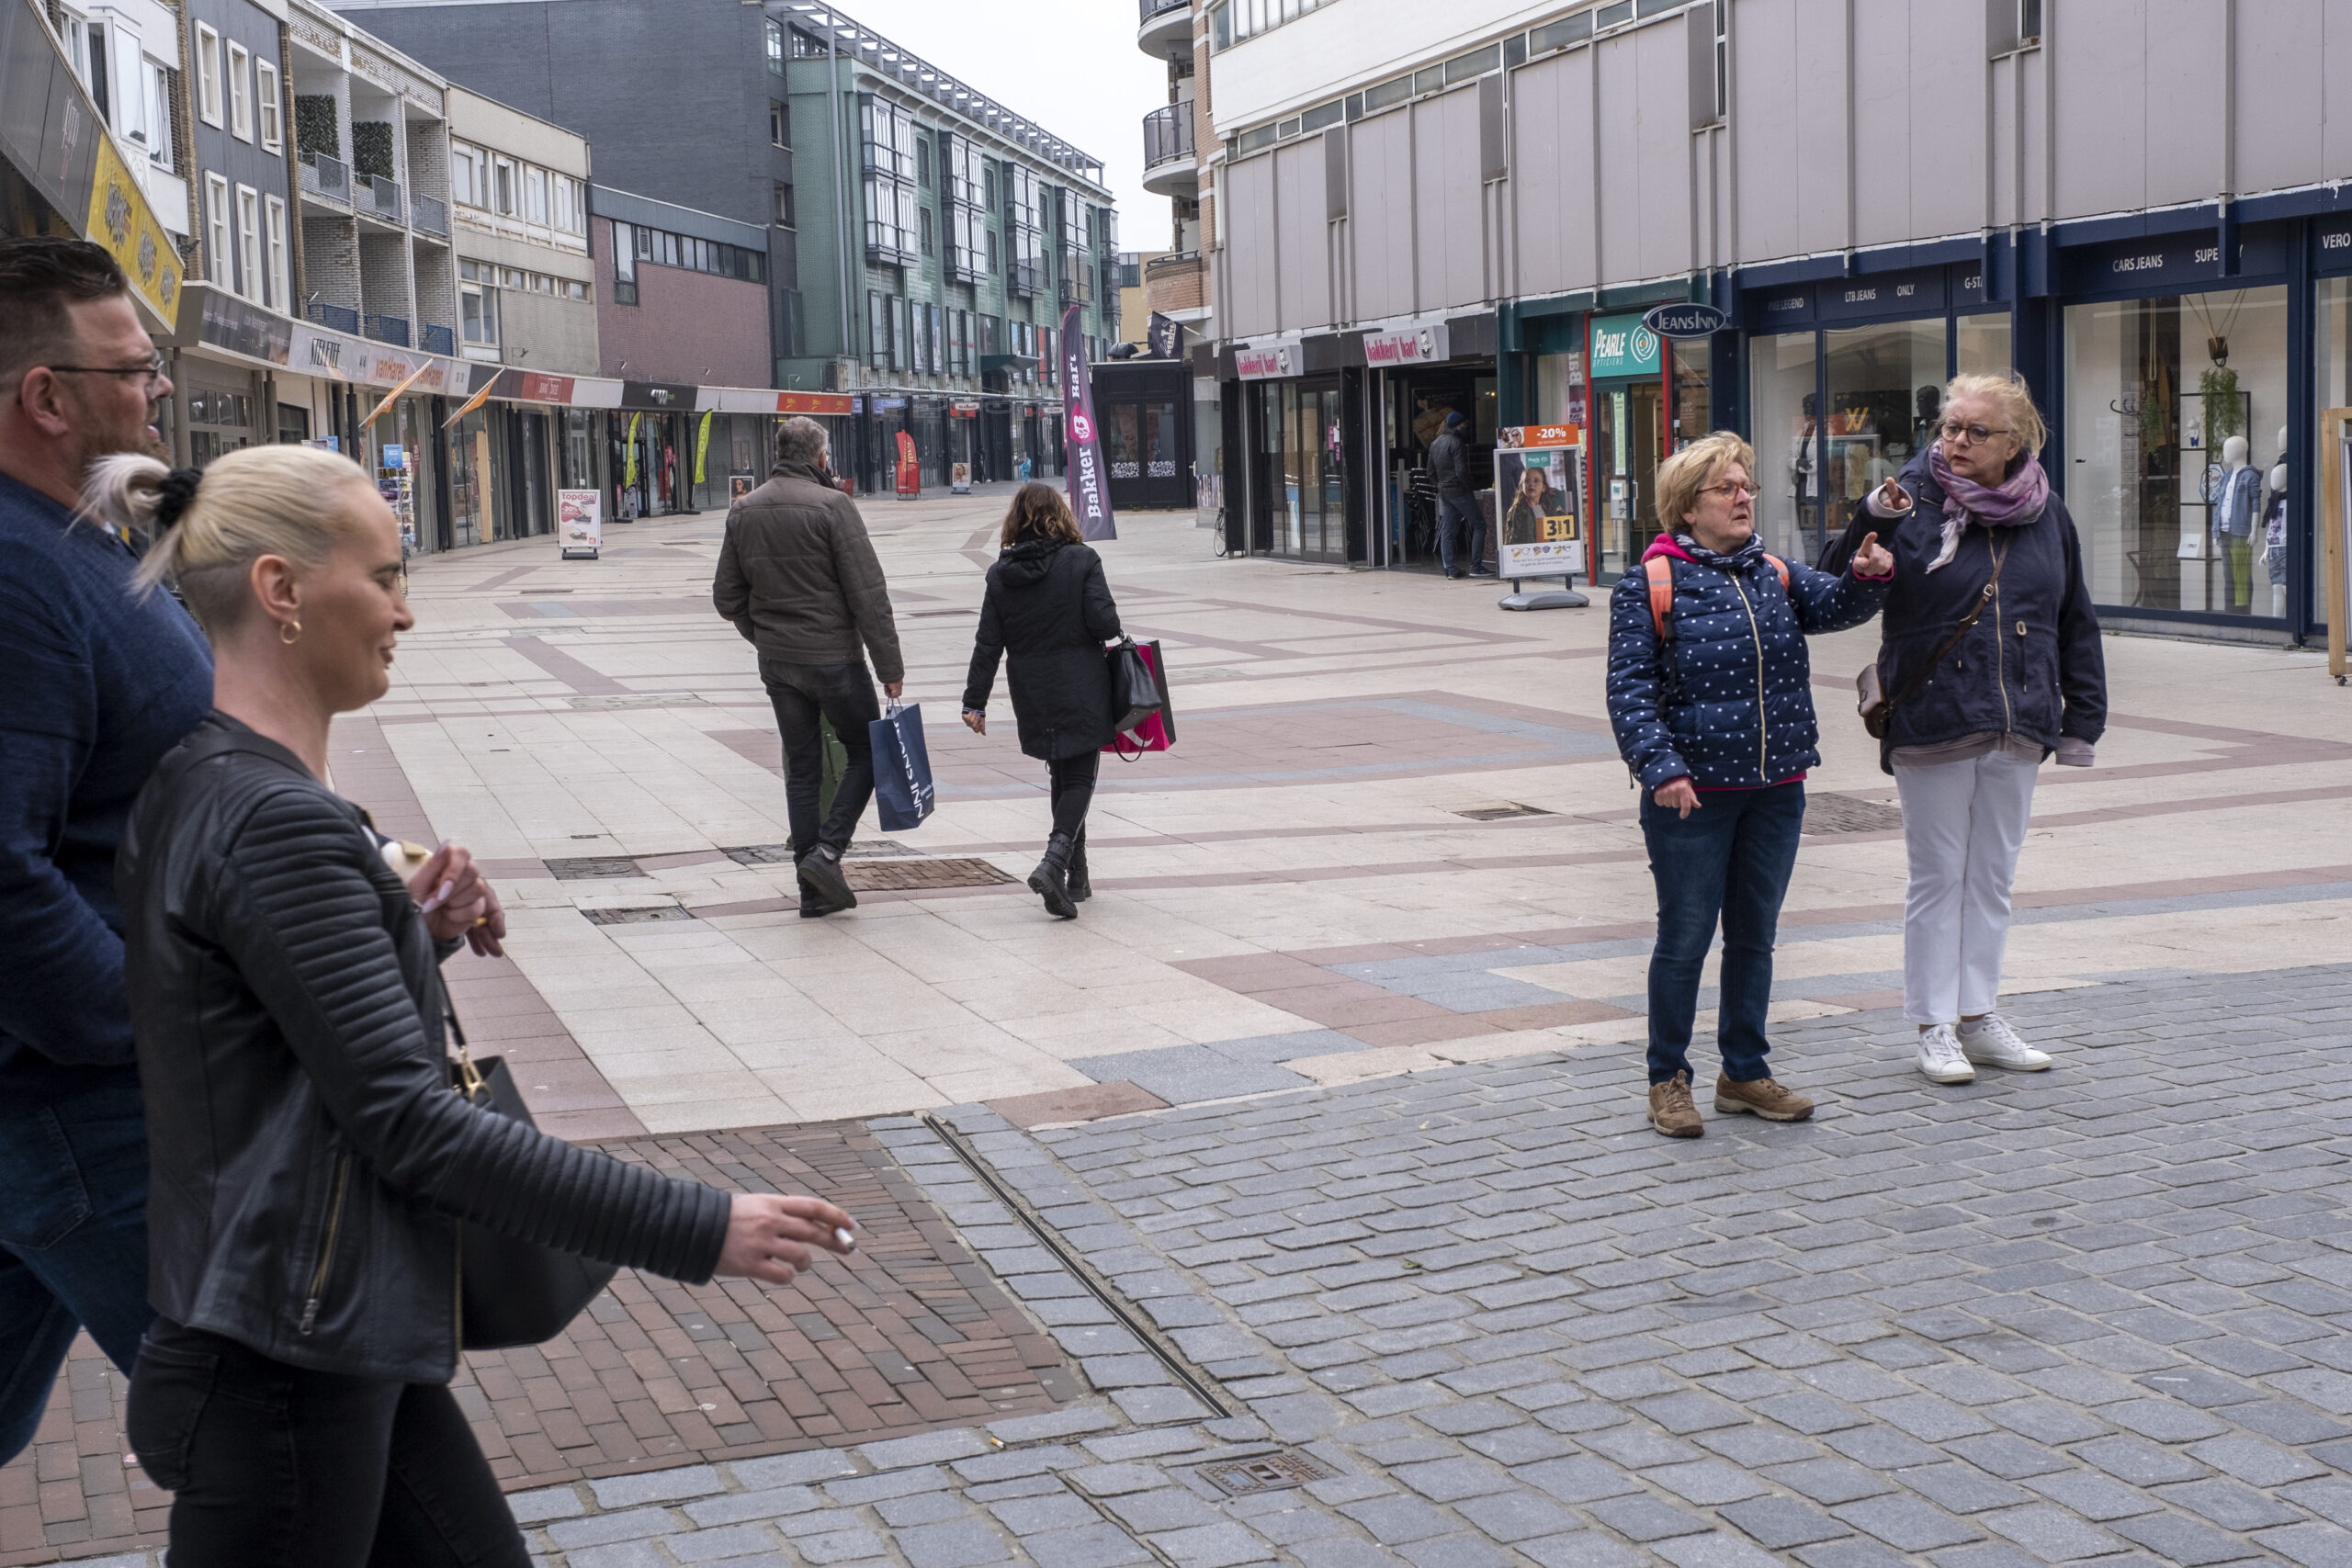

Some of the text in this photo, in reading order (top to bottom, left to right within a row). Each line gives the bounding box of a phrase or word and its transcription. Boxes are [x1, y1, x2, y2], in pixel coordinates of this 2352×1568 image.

[2322, 232, 2351, 250] VERO
[2112, 254, 2164, 273] CARS JEANS
[1845, 288, 1876, 302] LTB JEANS
[1896, 284, 1915, 298] ONLY
[376, 355, 406, 382] vanHaren
[1536, 427, 1567, 439] -20%
[1080, 446, 1102, 519] Bakker
[561, 492, 597, 502] topdeal
[1546, 519, 1557, 536] 3
[1563, 518, 1571, 536] 1
